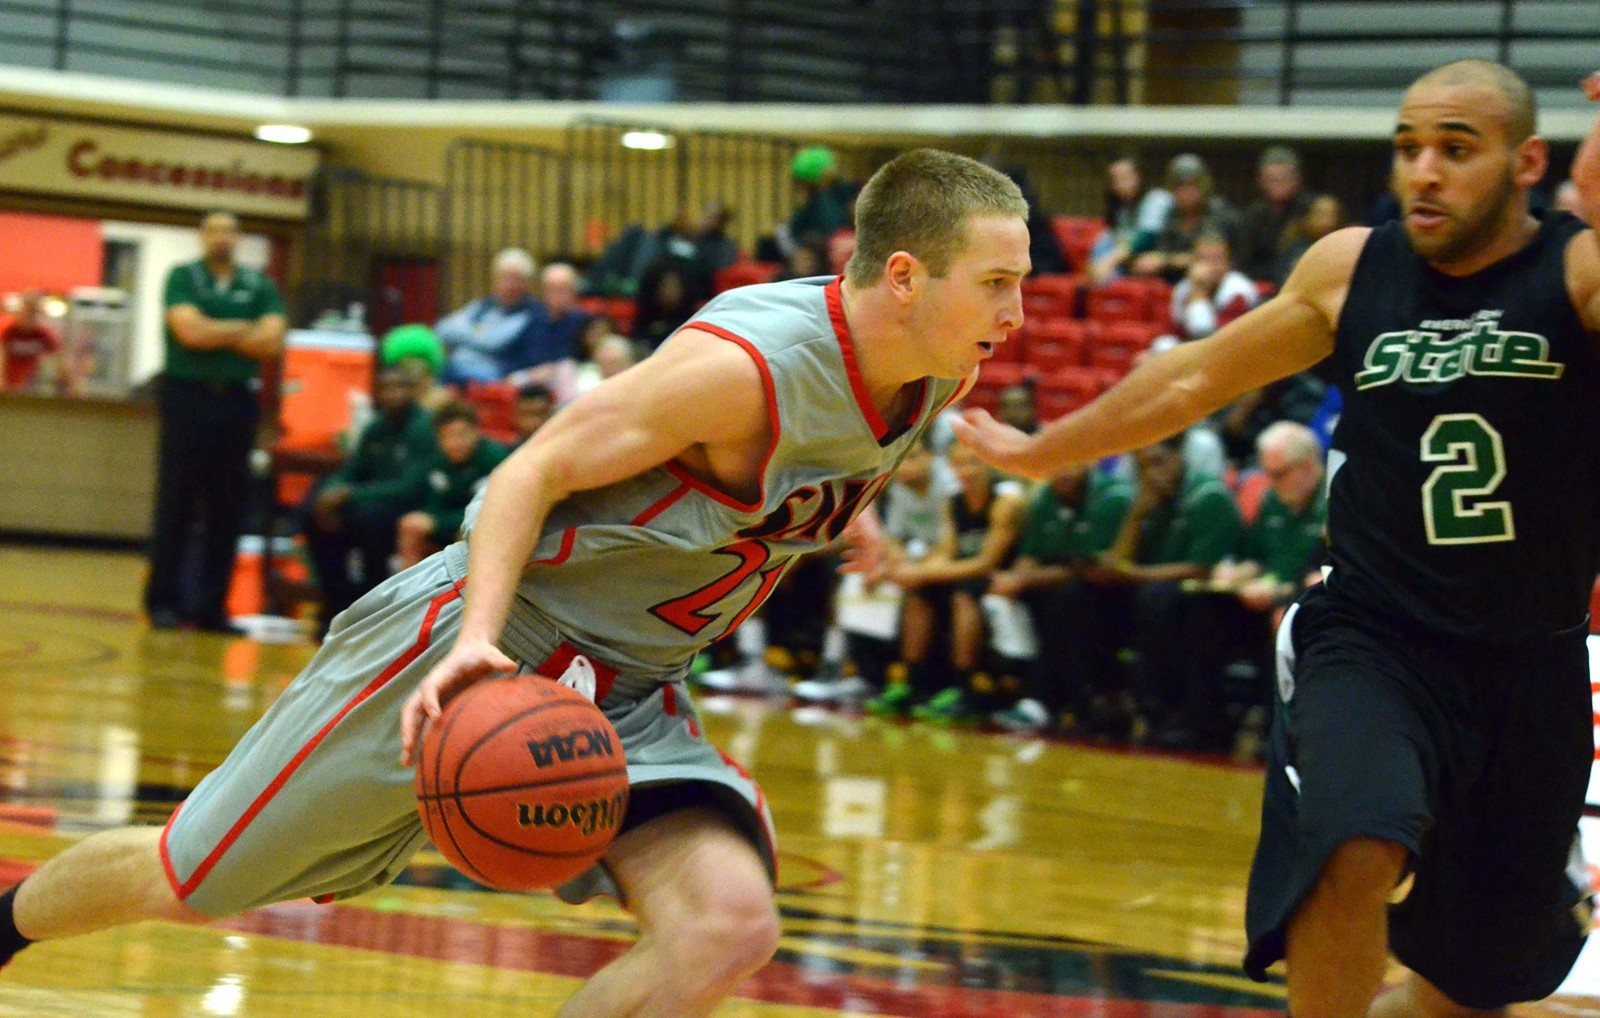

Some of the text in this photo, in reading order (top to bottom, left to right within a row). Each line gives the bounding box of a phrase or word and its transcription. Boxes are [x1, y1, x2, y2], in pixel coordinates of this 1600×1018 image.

[1354, 320, 1565, 391] State
[1419, 413, 1516, 545] 2
[646, 538, 796, 643] 21
[526, 729, 615, 769] NCAA
